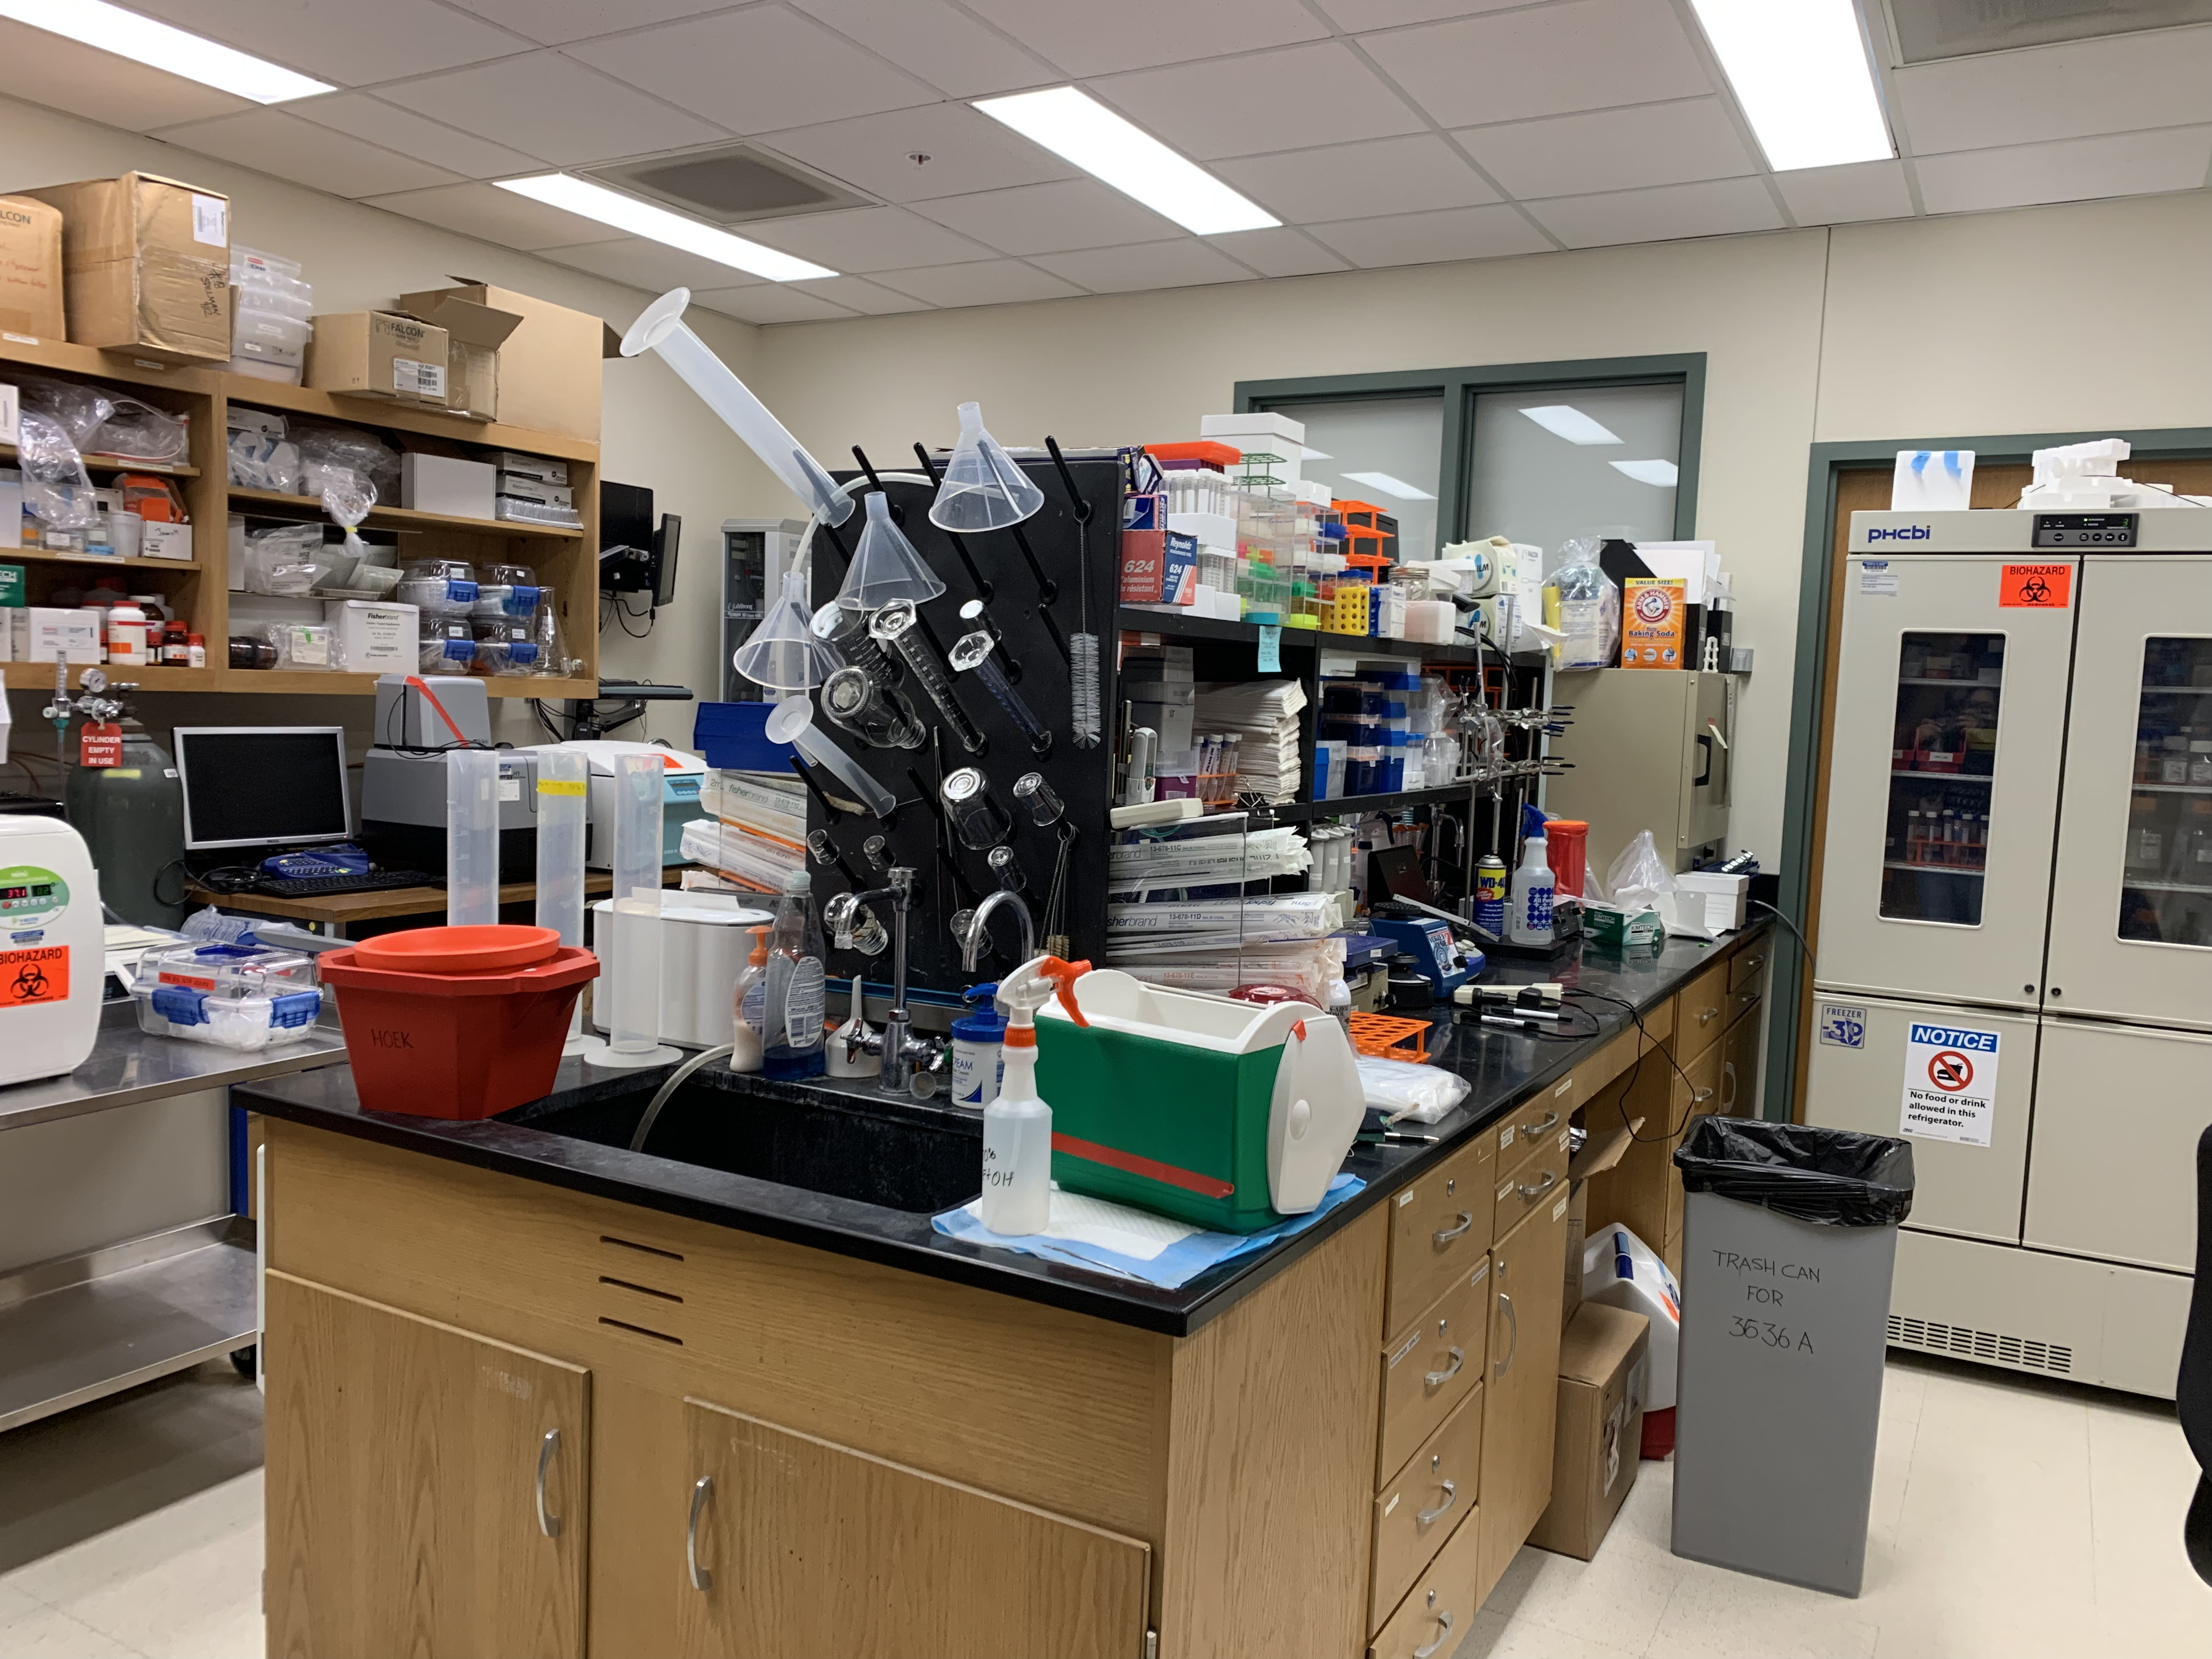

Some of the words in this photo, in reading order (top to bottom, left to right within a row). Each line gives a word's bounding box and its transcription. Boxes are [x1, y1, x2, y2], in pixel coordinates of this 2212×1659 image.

[391, 323, 424, 338] FALCON
[2122, 518, 2129, 527] 3
[1170, 537, 1193, 550] Reynolds
[1124, 560, 1155, 573] 624
[1169, 563, 1183, 574] 624
[2010, 566, 2066, 575] BIOHAZARD
[1637, 596, 1646, 610] ARM
[1649, 590, 1669, 610] HAMMER
[729, 784, 769, 804] fisherbrand
[1827, 1007, 1862, 1018] FREEZER
[371, 1028, 414, 1049] HOEK
[1915, 1027, 1994, 1051] NOTICE
[1910, 1091, 1923, 1099] No
[1925, 1092, 1947, 1103] food
[1961, 1098, 1987, 1109] drink
[1909, 1102, 1945, 1114] allowed
[1959, 1109, 1976, 1118] this
[1908, 1114, 1965, 1127] refrigerator.
[983, 1147, 996, 1163] 0%
[1712, 1250, 1775, 1277] TRASH
[1781, 1264, 1820, 1283] CAN
[1747, 1285, 1783, 1307] FOR
[1797, 1331, 1814, 1354] A
